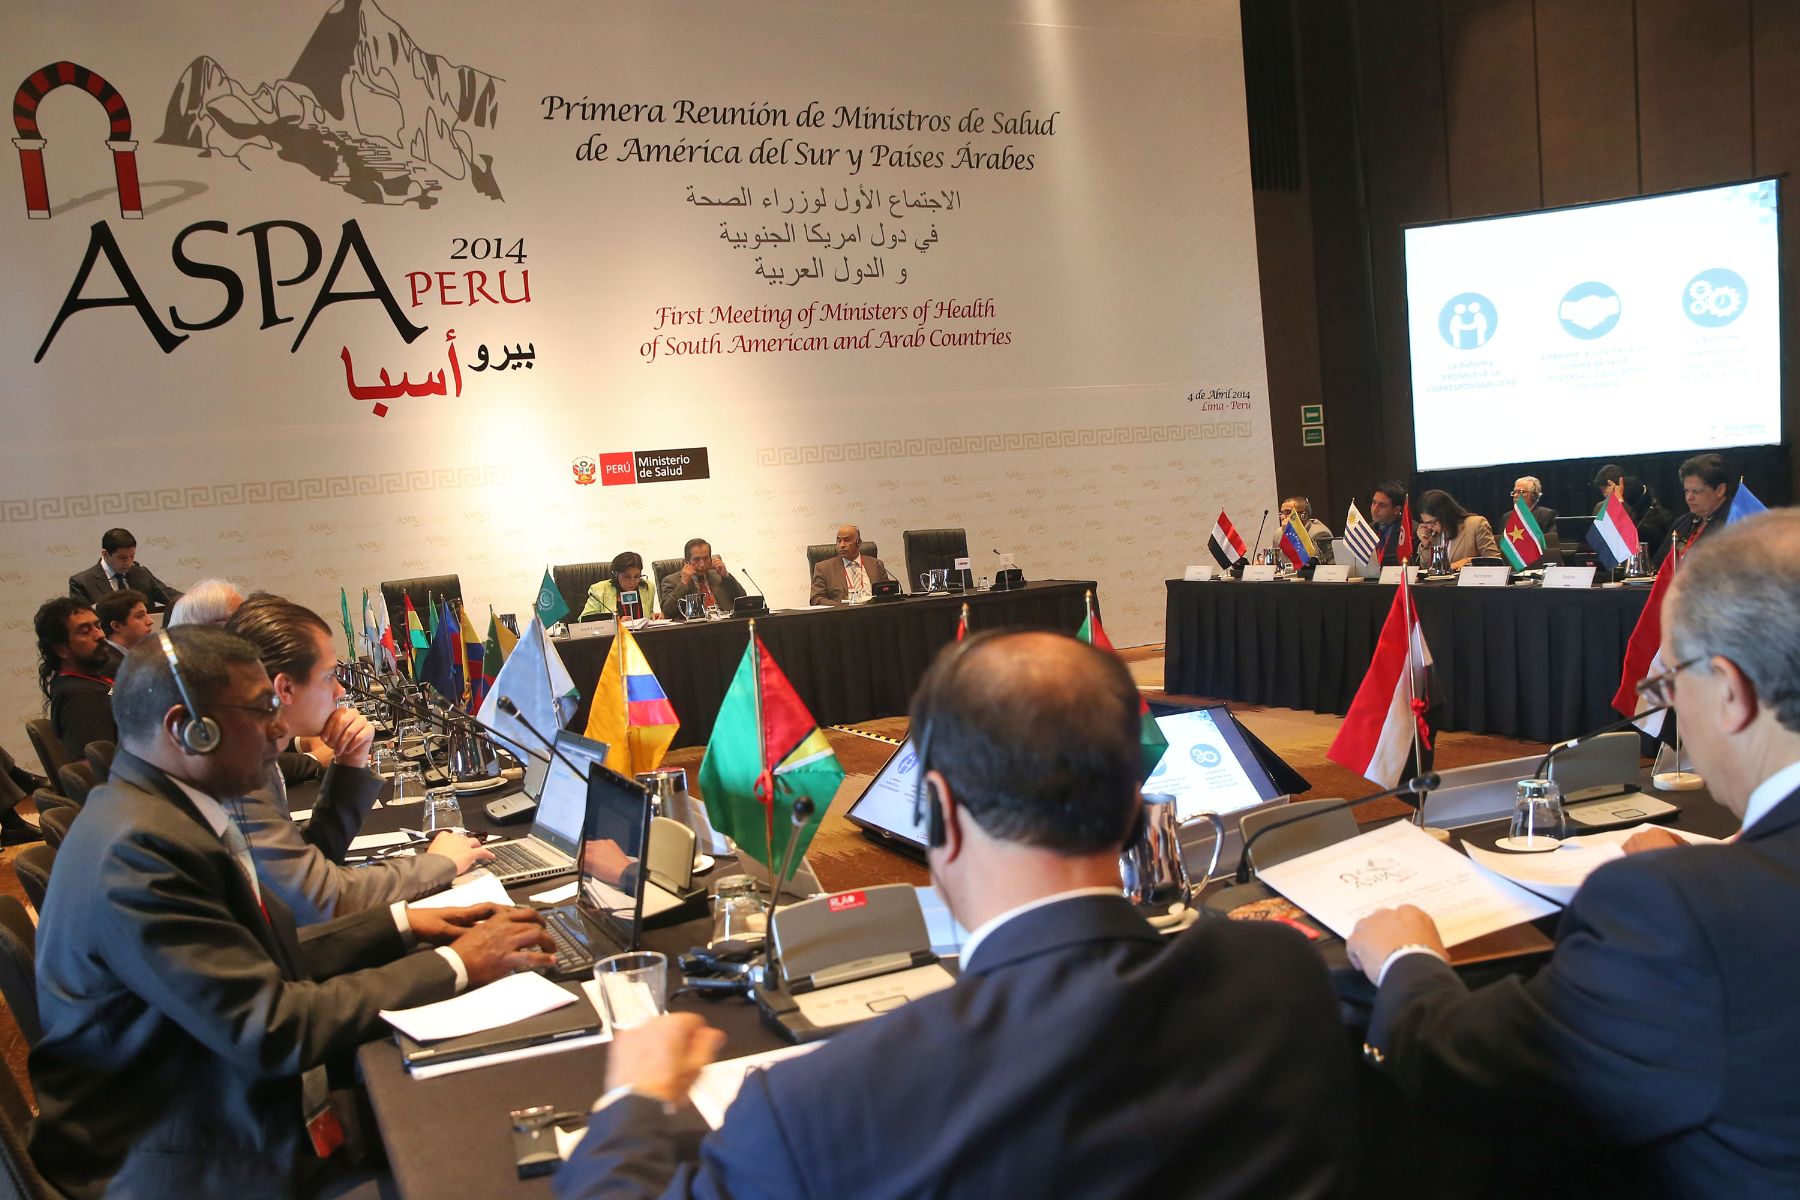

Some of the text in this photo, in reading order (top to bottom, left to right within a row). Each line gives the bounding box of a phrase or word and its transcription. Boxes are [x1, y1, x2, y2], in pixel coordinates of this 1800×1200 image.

[541, 96, 1060, 135] Primera Reunión de Ministros de Salud
[576, 133, 1034, 175] de América del Sur y Países Árabes
[687, 184, 960, 218] الاجتماع الأول لوزراء الصحة
[451, 238, 527, 264] 2014
[720, 221, 938, 253] في دول امريكا الجنوبية
[755, 256, 907, 286] و الدول العربية
[34, 219, 430, 364] ASPA
[405, 270, 531, 307] PERU
[654, 298, 996, 330] First Meeting of Ministers of Health
[468, 343, 535, 372] بيرو
[640, 327, 1011, 363] of South American and Arab Countries
[341, 329, 462, 418] أسبا
[1187, 388, 1251, 402] 4 de Abril 2014
[1202, 401, 1224, 412] Lima
[606, 462, 631, 474] PERÚ
[638, 455, 690, 467] Ministerio
[640, 465, 683, 478] de Salud
